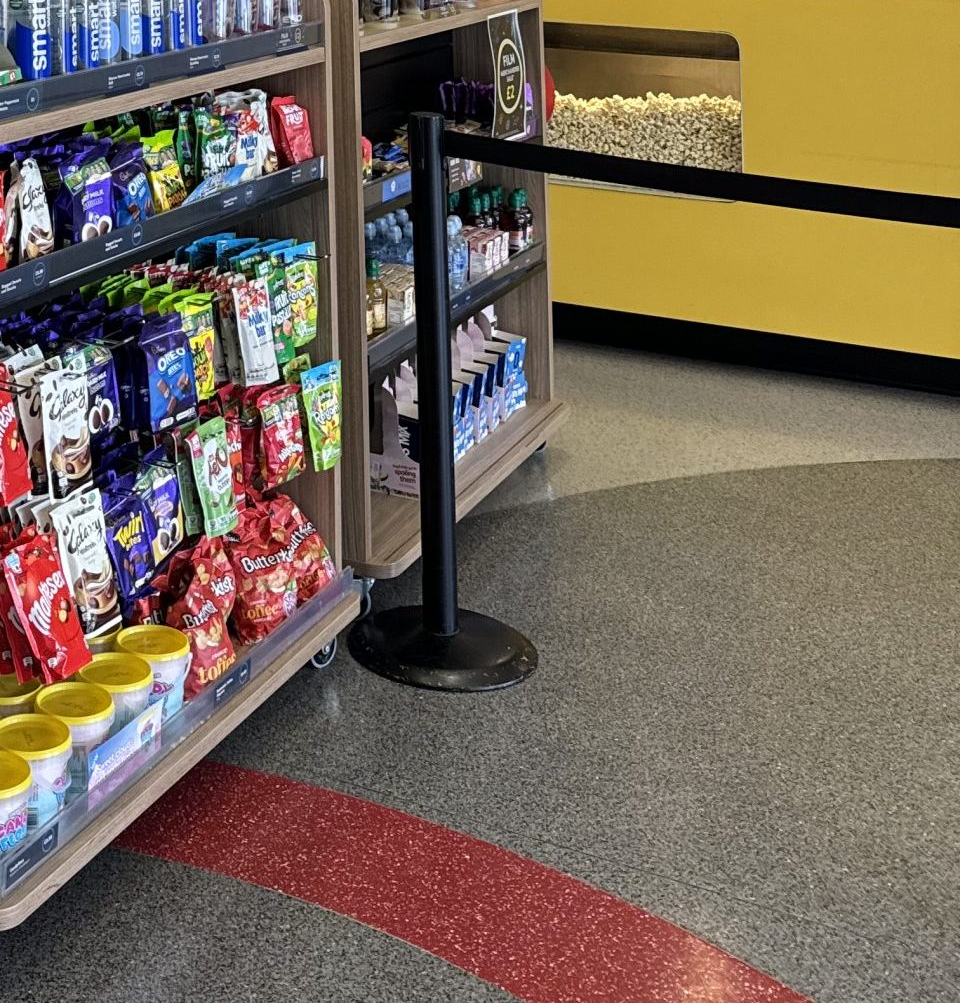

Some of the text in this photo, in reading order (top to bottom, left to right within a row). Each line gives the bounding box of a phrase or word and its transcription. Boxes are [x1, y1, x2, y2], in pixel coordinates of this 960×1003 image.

[70, 5, 78, 67] smart
[89, 2, 100, 62] smart
[503, 53, 516, 67] FILM
[506, 84, 515, 100] £2
[157, 347, 186, 373] OREO
[49, 386, 85, 423] Galaxy
[66, 518, 104, 555] Galaxy
[28, 570, 65, 636] Malteser
